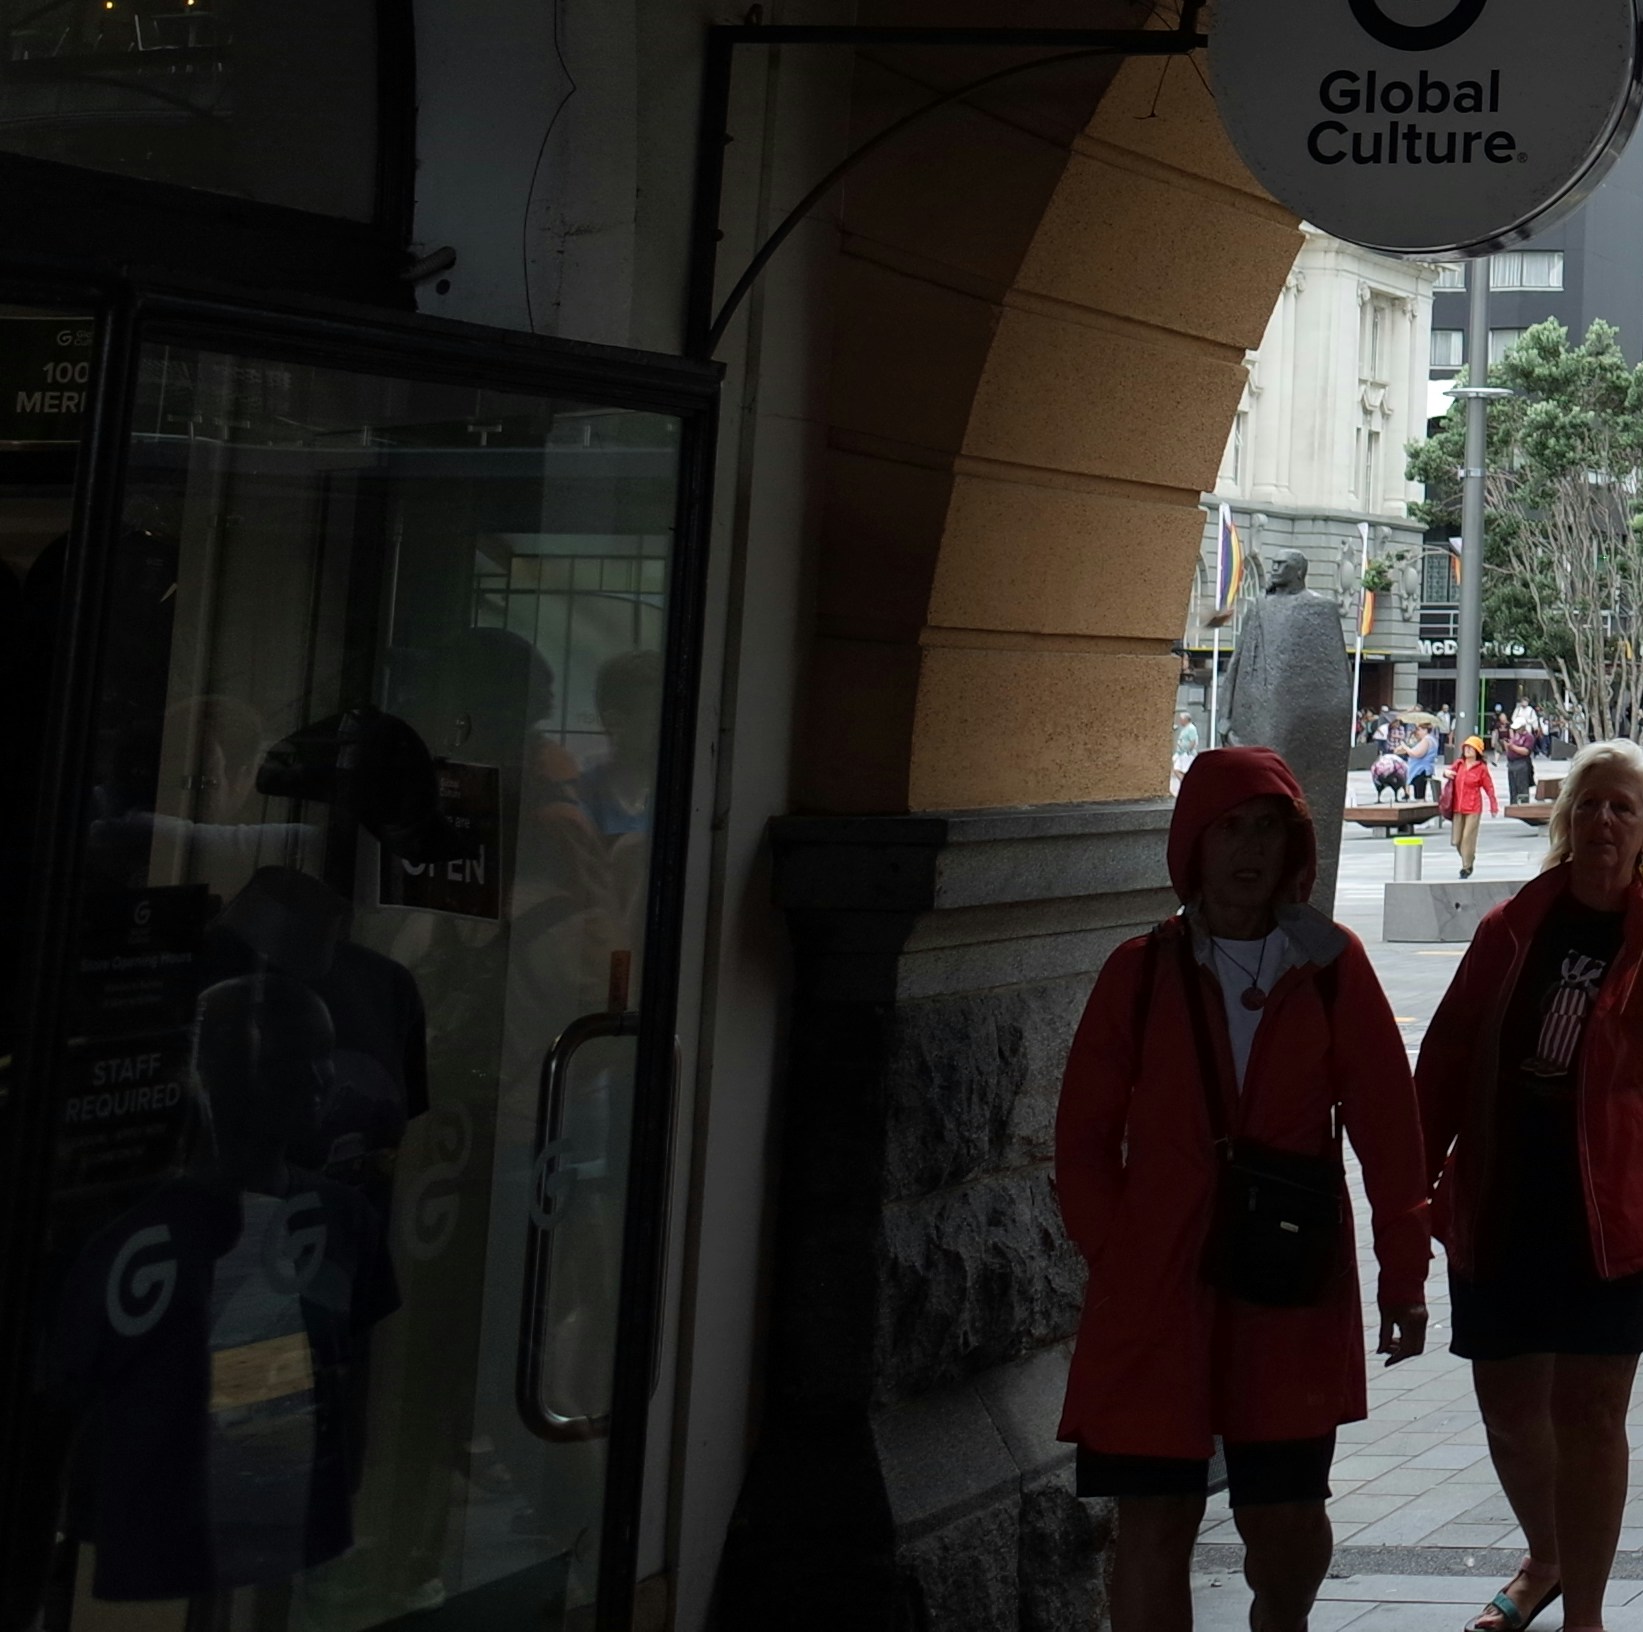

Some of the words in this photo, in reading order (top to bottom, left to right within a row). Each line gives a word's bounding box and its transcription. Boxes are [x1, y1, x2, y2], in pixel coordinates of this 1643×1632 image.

[1319, 69, 1500, 115] Global
[92, 1052, 163, 1087] STAFF
[65, 1082, 182, 1123] REQUIRED
